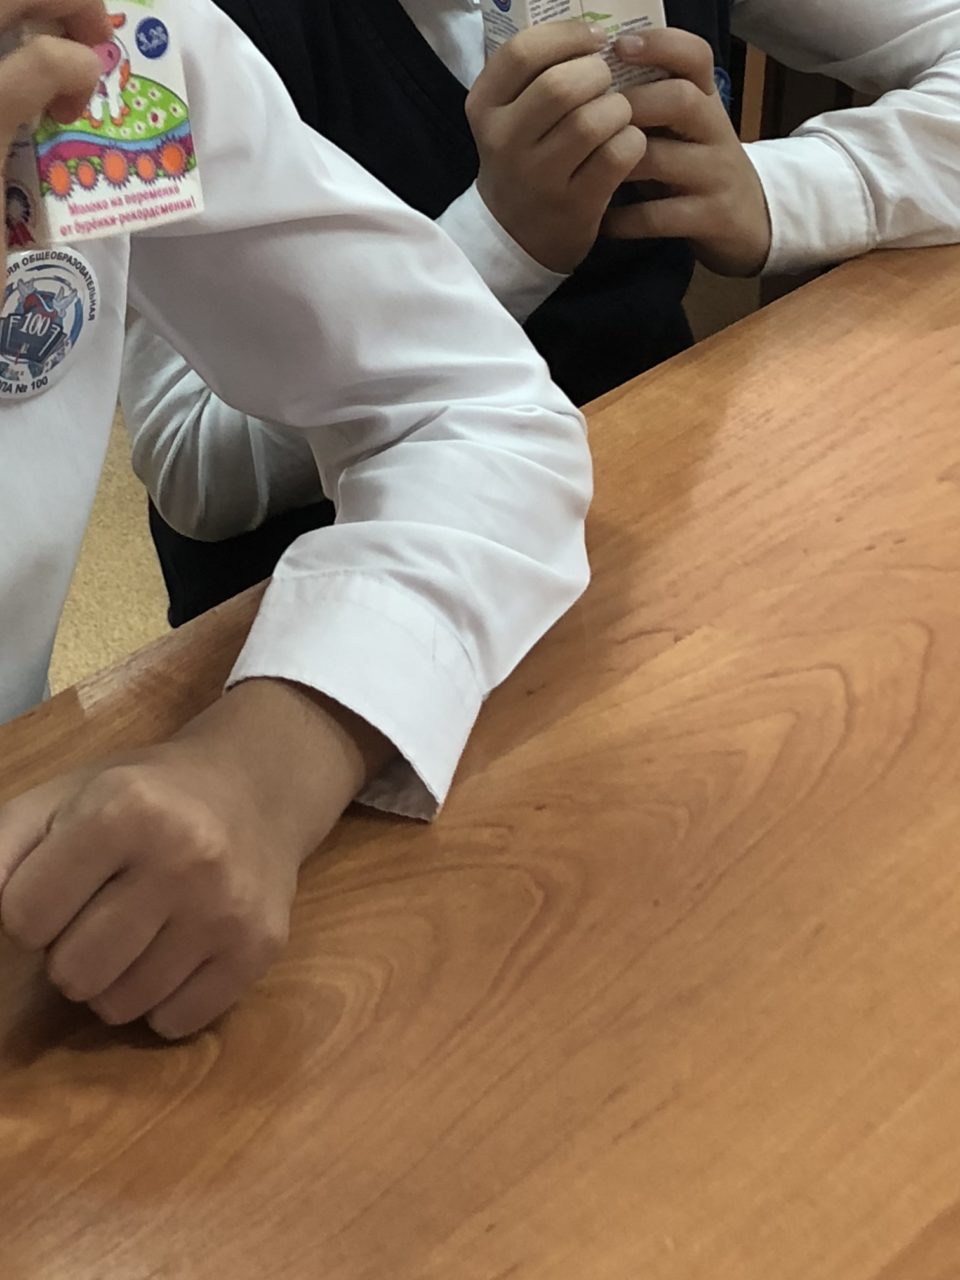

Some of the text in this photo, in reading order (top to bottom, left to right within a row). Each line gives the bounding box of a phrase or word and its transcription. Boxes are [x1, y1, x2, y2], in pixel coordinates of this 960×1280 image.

[68, 200, 109, 216] Молоко
[60, 224, 73, 236] от
[22, 251, 96, 321] ОБЩЕОБРАЗОВАТЕЛЬНАЯ
[19, 312, 51, 337] 100
[31, 376, 49, 390] 100
